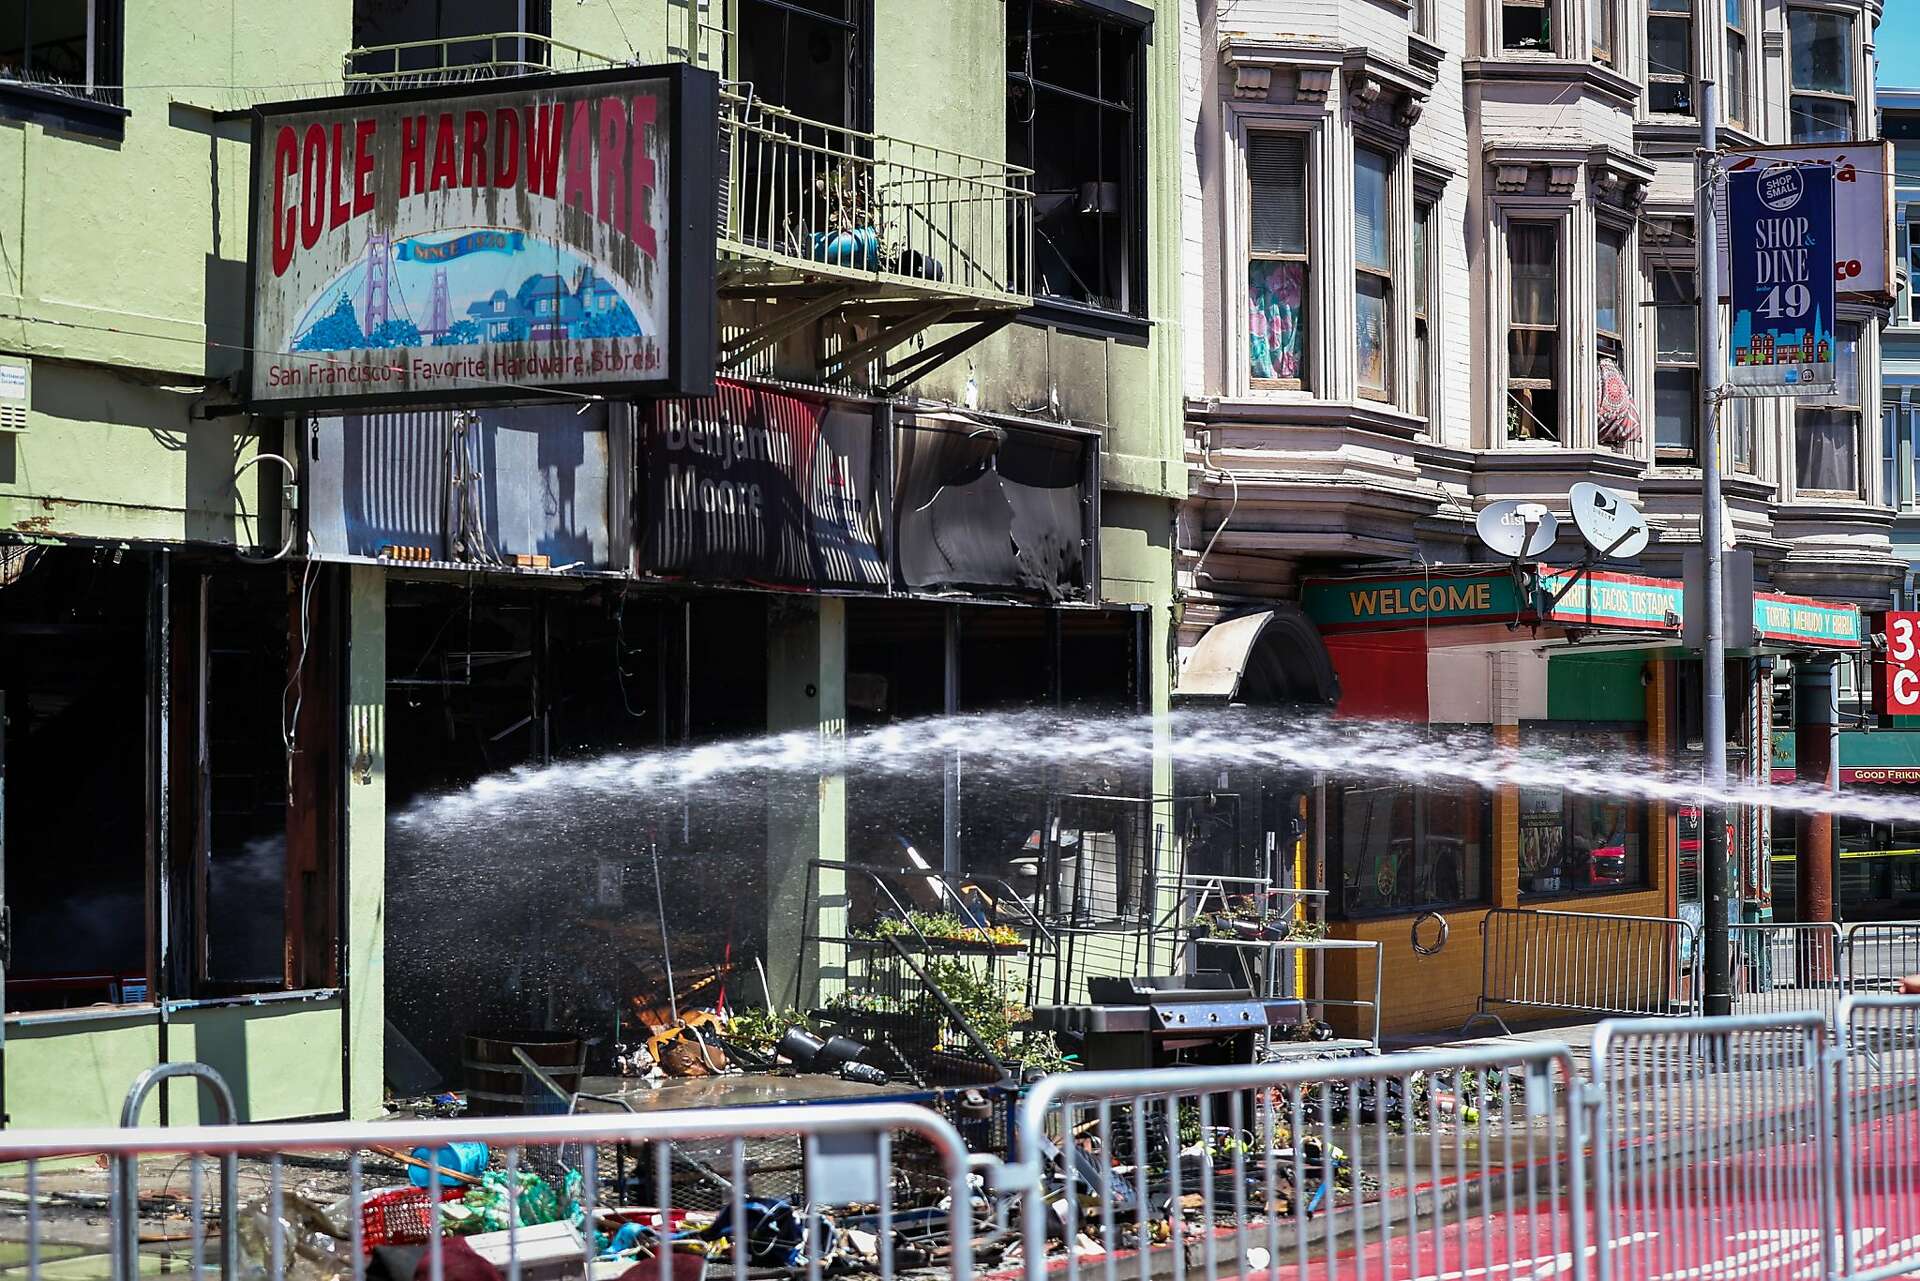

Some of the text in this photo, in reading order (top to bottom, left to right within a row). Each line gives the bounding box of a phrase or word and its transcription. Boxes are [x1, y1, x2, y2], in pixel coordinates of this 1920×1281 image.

[272, 95, 657, 278] COLE HARDWARE
[1766, 174, 1792, 190] SHOP
[1766, 182, 1797, 199] SMALL
[1755, 216, 1809, 249] SHOP
[1755, 248, 1810, 284] DINE
[1756, 283, 1811, 319] 49
[269, 348, 661, 387] San Francisco's Favorite Hardware Stores!
[1501, 509, 1526, 526] dis
[1349, 583, 1491, 616] WELCOME
[1765, 606, 1791, 628] TORTAS
[1794, 611, 1823, 634] MENUDO
[1825, 613, 1831, 631] Y
[1855, 770, 1886, 779] GOOD
